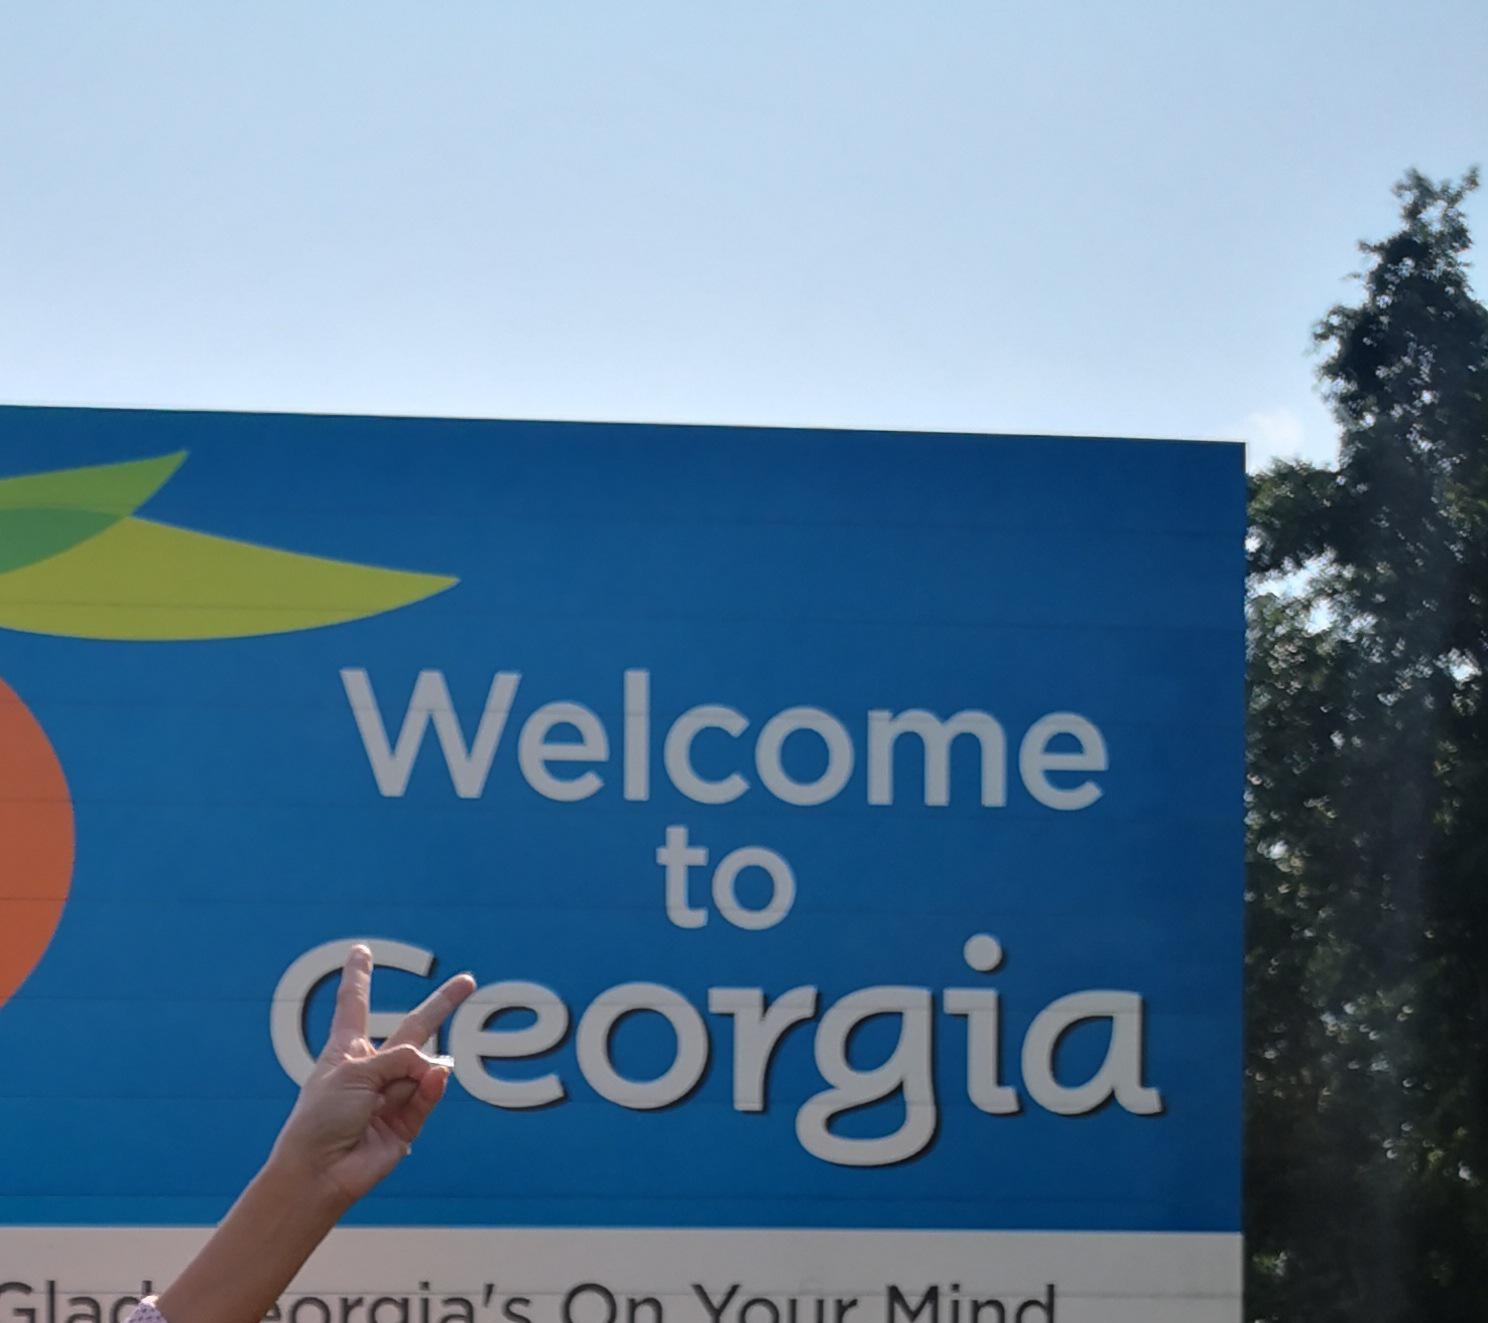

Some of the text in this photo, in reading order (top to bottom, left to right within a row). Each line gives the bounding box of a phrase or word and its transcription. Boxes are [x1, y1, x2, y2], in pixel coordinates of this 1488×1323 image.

[339, 667, 1109, 811] Welcome
[656, 825, 797, 931] to
[269, 934, 1166, 1168] Georgia
